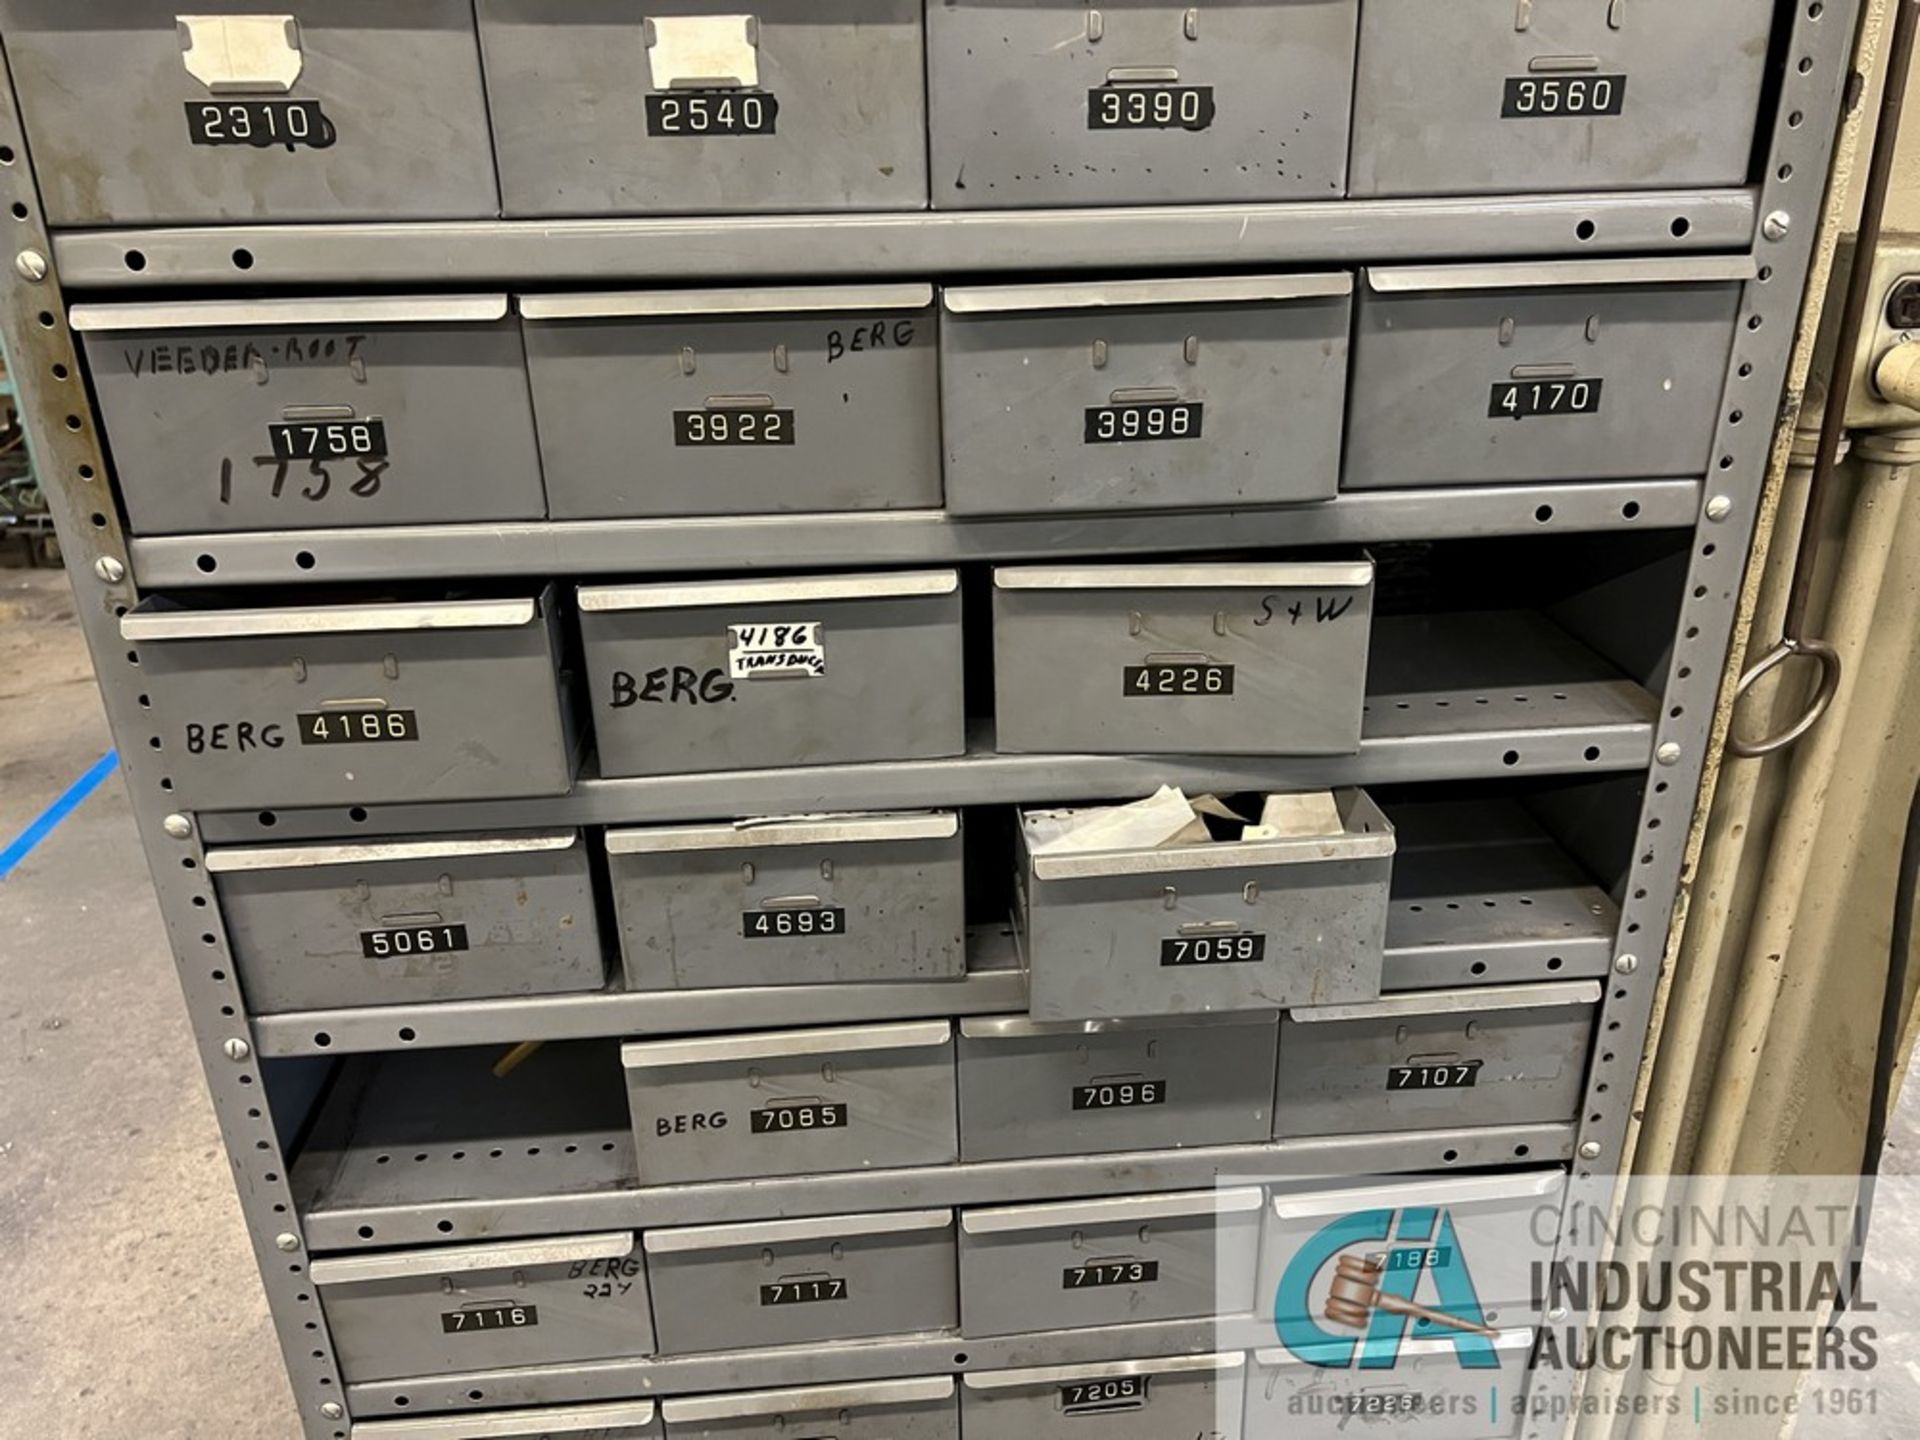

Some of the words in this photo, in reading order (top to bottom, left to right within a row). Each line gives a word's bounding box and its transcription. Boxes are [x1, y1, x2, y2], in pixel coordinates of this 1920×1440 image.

[1102, 92, 1198, 123] 3390
[1517, 81, 1610, 111] 3560
[202, 106, 307, 137] 2310
[662, 99, 761, 130] 2540
[827, 320, 915, 363] BERG
[1503, 384, 1588, 411] 4170
[688, 414, 780, 440] 3922
[1098, 408, 1188, 437] 3998
[282, 426, 370, 454] 1758
[220, 457, 389, 504] 1758
[740, 626, 807, 646] 4186
[1136, 669, 1221, 691] 4226
[186, 722, 284, 754] BERG
[313, 714, 405, 738] 4186
[756, 912, 834, 933] 4693
[373, 929, 452, 953] 5061
[1175, 939, 1252, 961] 7059
[1400, 1067, 1468, 1086] 7107
[1085, 1085, 1154, 1105] 7096
[656, 1111, 727, 1137] BERG
[763, 1108, 835, 1128] 7085
[568, 1258, 639, 1279] BERG
[1075, 1264, 1142, 1284] 7173
[772, 1282, 841, 1301] 7117
[453, 1309, 525, 1329] 7116
[1074, 1381, 1133, 1401] 7205
